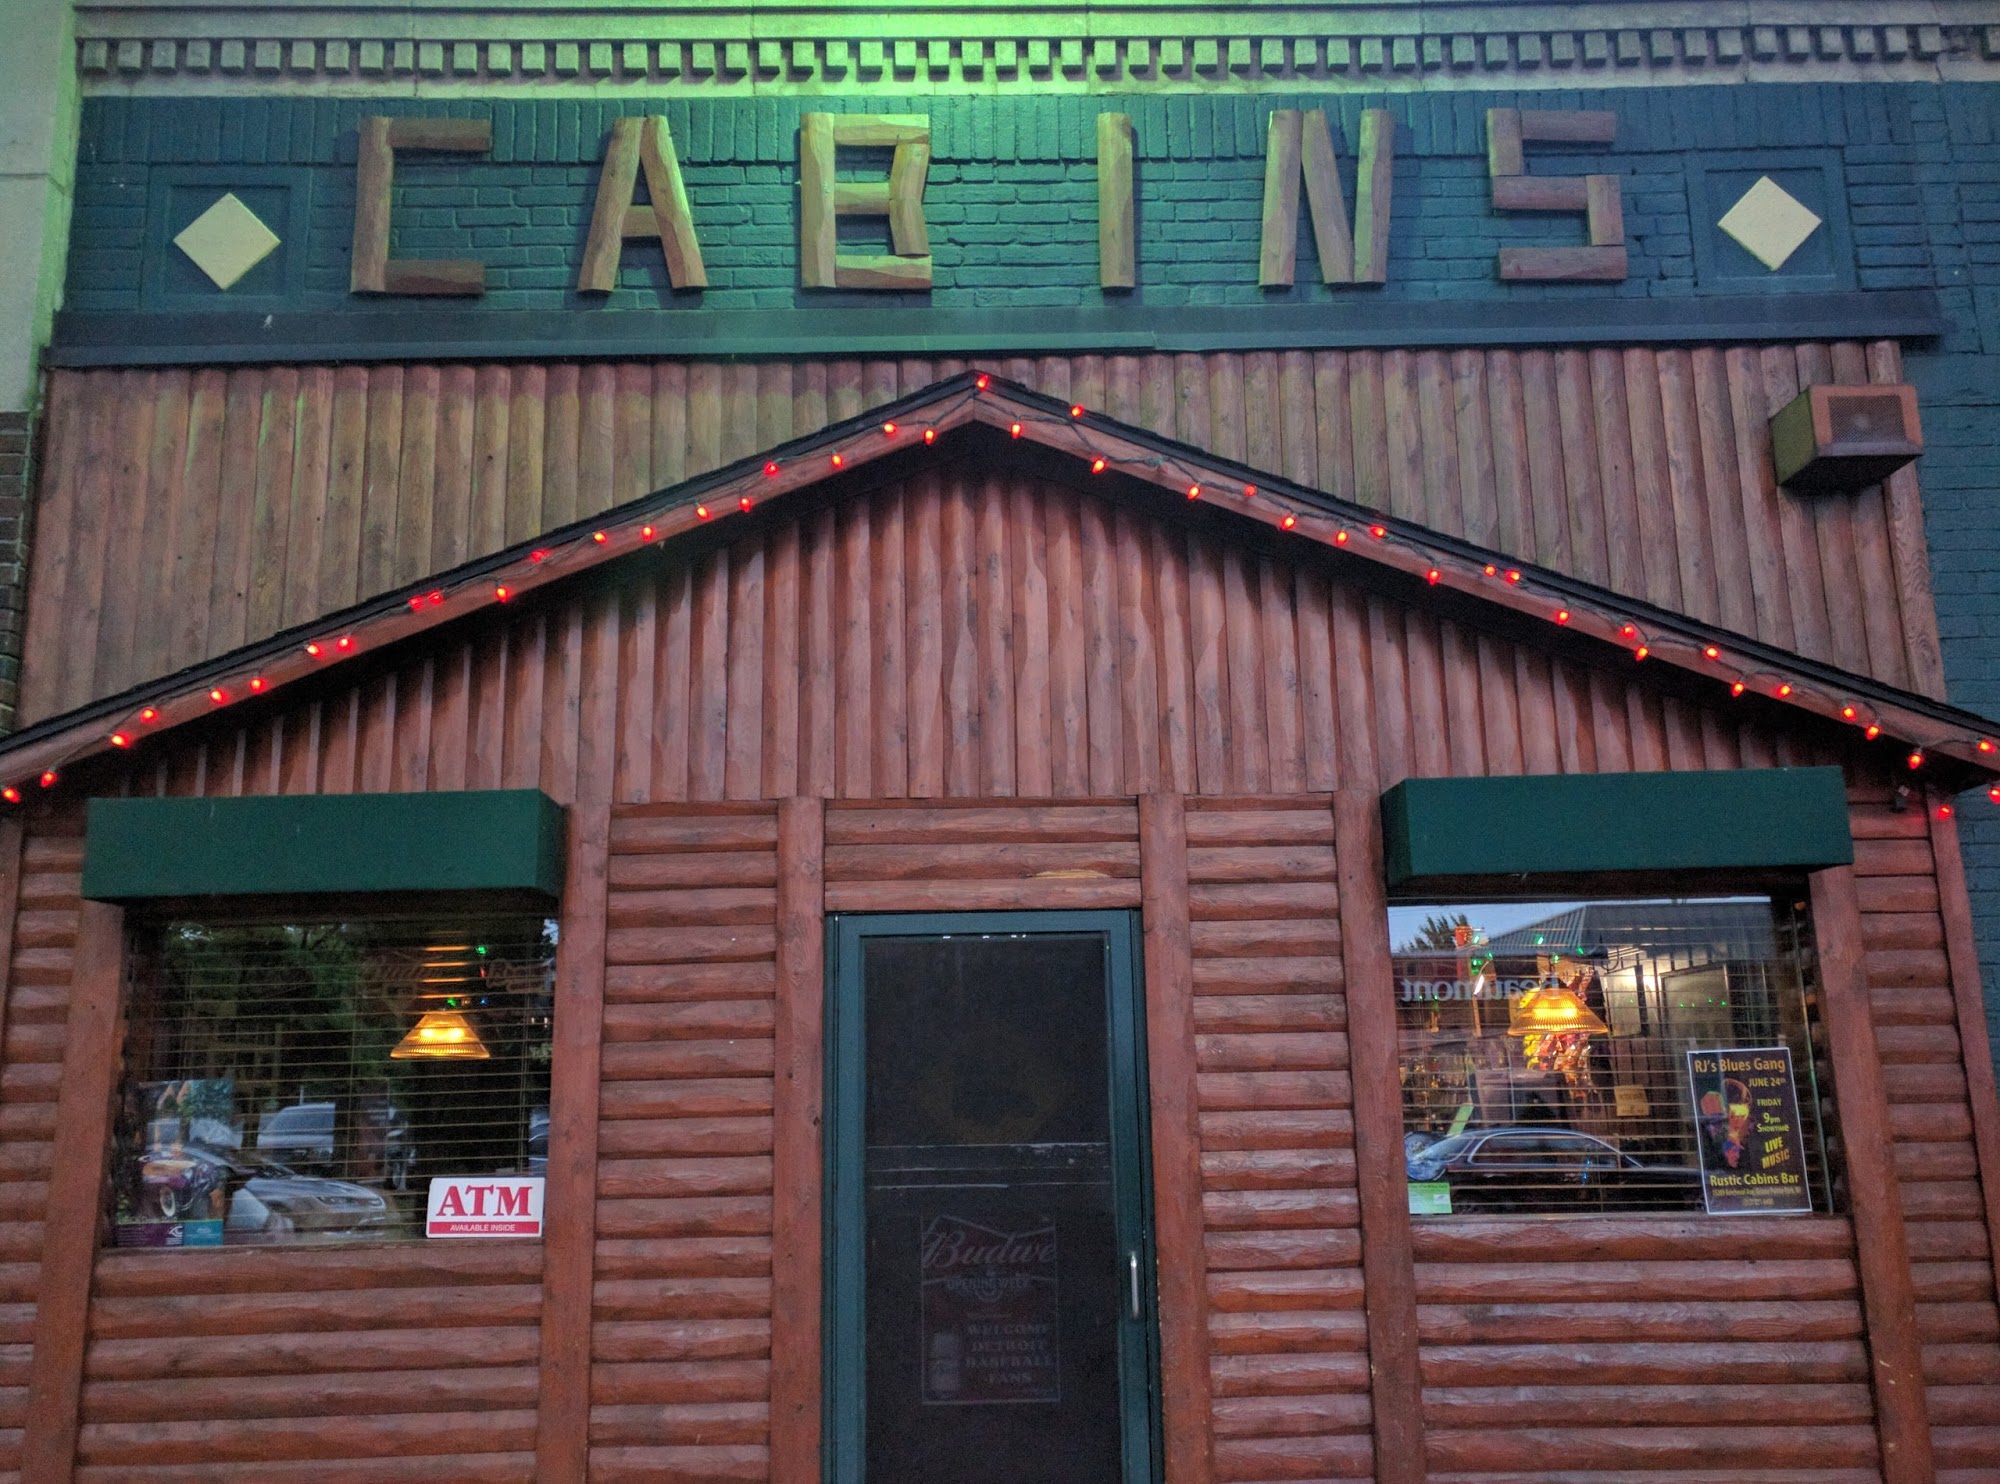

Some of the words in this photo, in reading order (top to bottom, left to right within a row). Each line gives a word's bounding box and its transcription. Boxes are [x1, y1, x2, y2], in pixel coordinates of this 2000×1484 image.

[350, 109, 1628, 293] CABINS
[1695, 1060, 1717, 1073] RJ's
[1720, 1058, 1751, 1072] Blues
[1754, 1057, 1786, 1073] Gang
[1749, 1078, 1769, 1087] JUNE
[1757, 1098, 1782, 1107] FRIDAY
[1763, 1112, 1781, 1125] 9pm
[1764, 1136, 1783, 1153] LIVE
[1762, 1148, 1790, 1169] MUSIC
[1710, 1174, 1742, 1187] Rustic
[1743, 1173, 1779, 1185] Cabins
[1781, 1172, 1799, 1184] Bar
[436, 1184, 533, 1217] ATM
[449, 1224, 489, 1232] AVAILABLE
[490, 1223, 516, 1232] INSIDE
